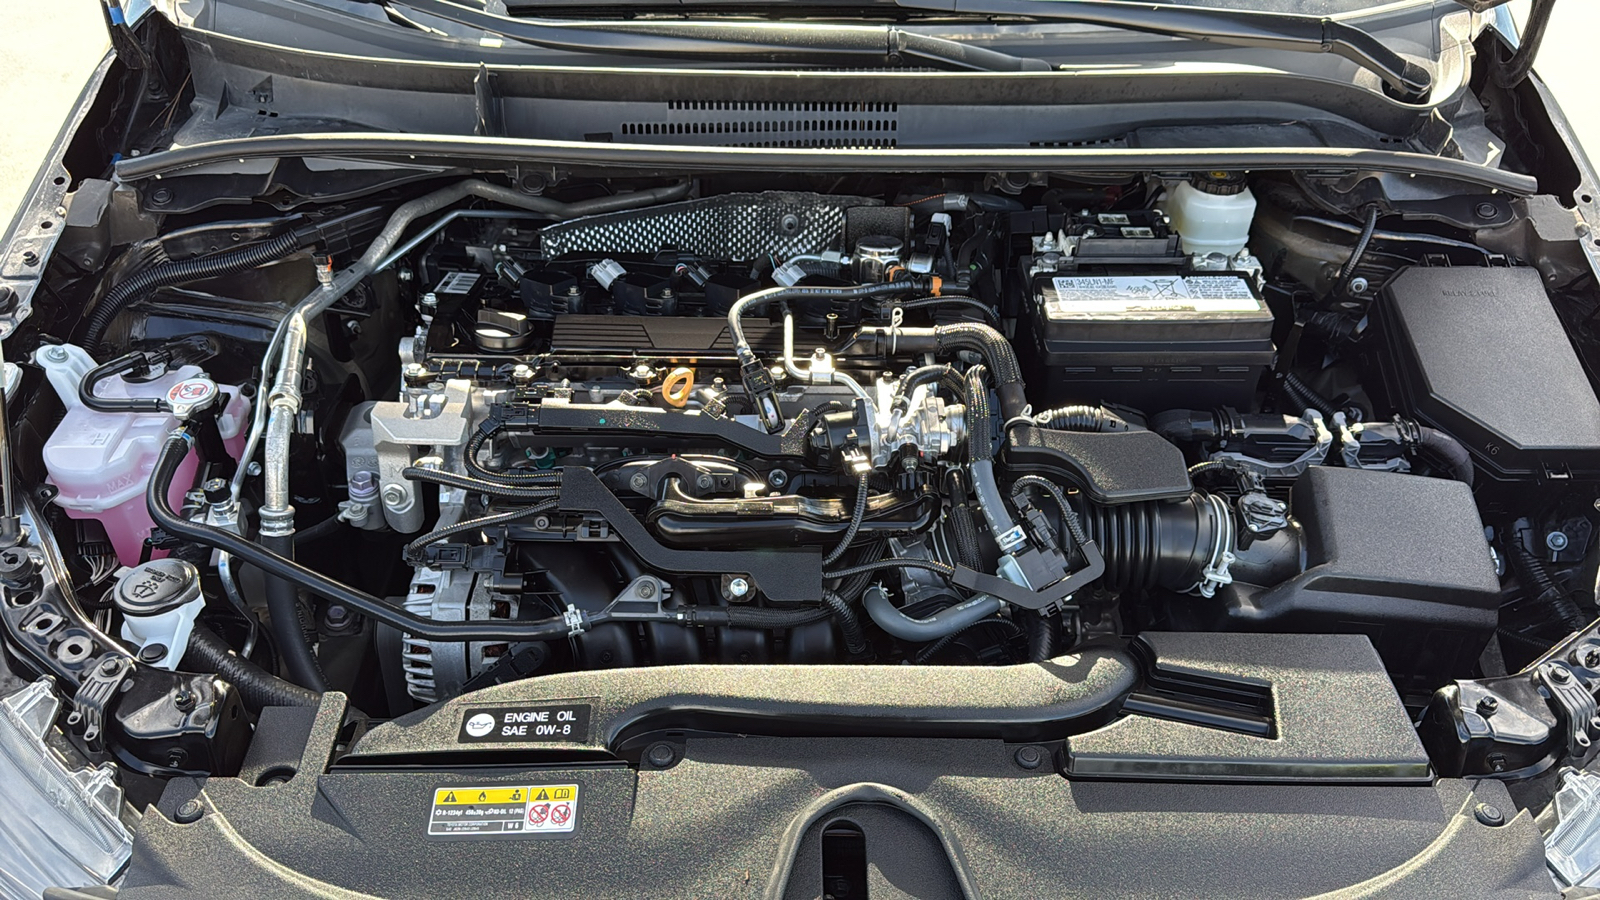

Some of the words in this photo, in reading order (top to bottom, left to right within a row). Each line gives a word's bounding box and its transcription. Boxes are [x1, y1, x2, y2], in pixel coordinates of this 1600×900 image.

[1485, 441, 1500, 455] K6
[106, 474, 134, 494] MAX
[504, 711, 550, 723] ENGINE
[556, 710, 577, 722] OIL
[501, 725, 528, 736] SAE
[535, 724, 571, 735] 0W-8
